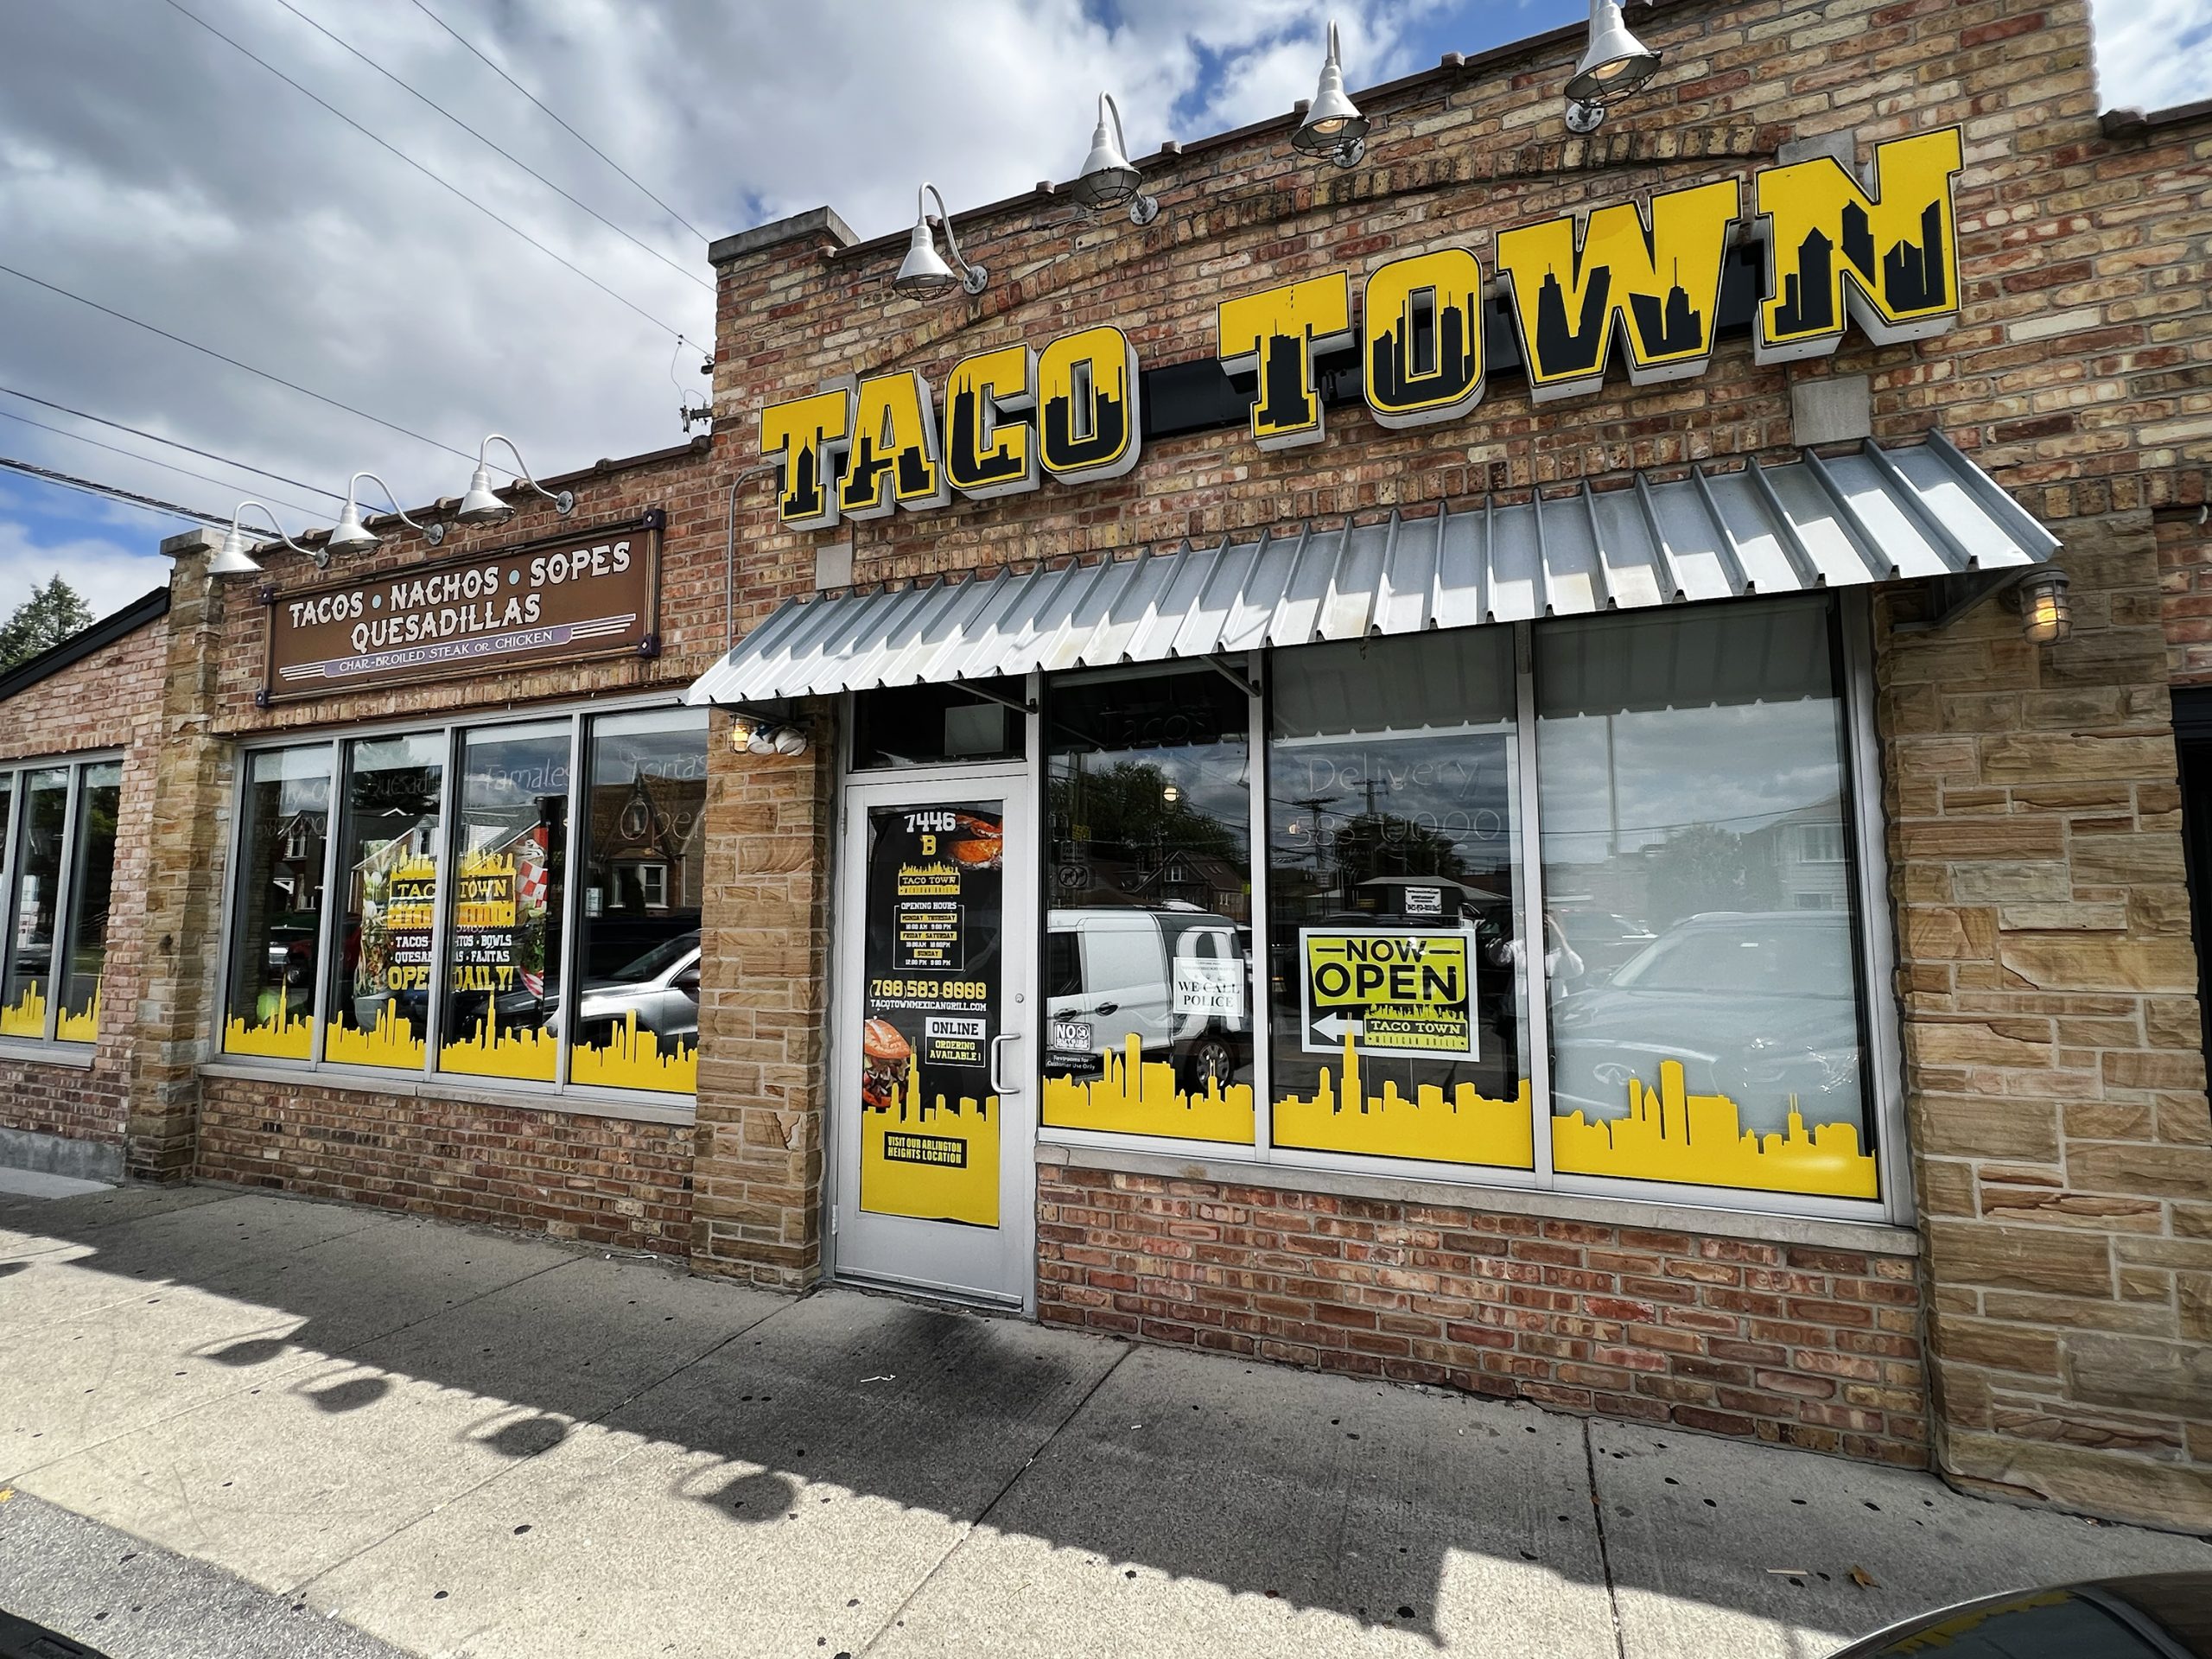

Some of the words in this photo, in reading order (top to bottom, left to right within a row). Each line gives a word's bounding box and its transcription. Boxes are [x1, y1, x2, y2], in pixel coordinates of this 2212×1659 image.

[760, 324, 1139, 530] TACO
[1217, 124, 1964, 450] TOWN
[289, 591, 364, 629] TACOS
[390, 567, 499, 612] NACHOS
[530, 541, 631, 588] SOPES
[351, 594, 542, 653] QUESADILLAS
[339, 650, 426, 671] CHAR-BROILED
[429, 645, 469, 658] STEAK
[495, 630, 553, 650] CHICKEN
[1309, 752, 1479, 798] Delivery
[904, 810, 957, 833] 7446
[921, 835, 937, 855] B
[902, 876, 926, 885] TACO
[397, 882, 435, 898] TAC
[933, 901, 957, 910] HOURS
[395, 936, 429, 948] TACOS
[480, 934, 512, 949] BOWLS
[471, 950, 511, 963] FAJITAS
[1346, 939, 1427, 963] NOW
[388, 965, 430, 991] OPE
[1315, 963, 1458, 1001] OPEN
[1178, 981, 1199, 992] WE
[1203, 982, 1240, 994] CALL
[1184, 995, 1234, 1007] POLICE
[932, 1021, 979, 1036] ONLINE
[1057, 1024, 1076, 1039] NO
[1370, 1020, 1411, 1033] TACO
[1415, 1022, 1461, 1034] TOWN
[935, 1040, 976, 1051] ORDERING
[887, 1135, 906, 1147] VISIT
[906, 1138, 921, 1149] OUR
[922, 1139, 962, 1154] ARLINGTON
[887, 1146, 921, 1160] HEIGHTS
[922, 1149, 962, 1164] LOCATION
